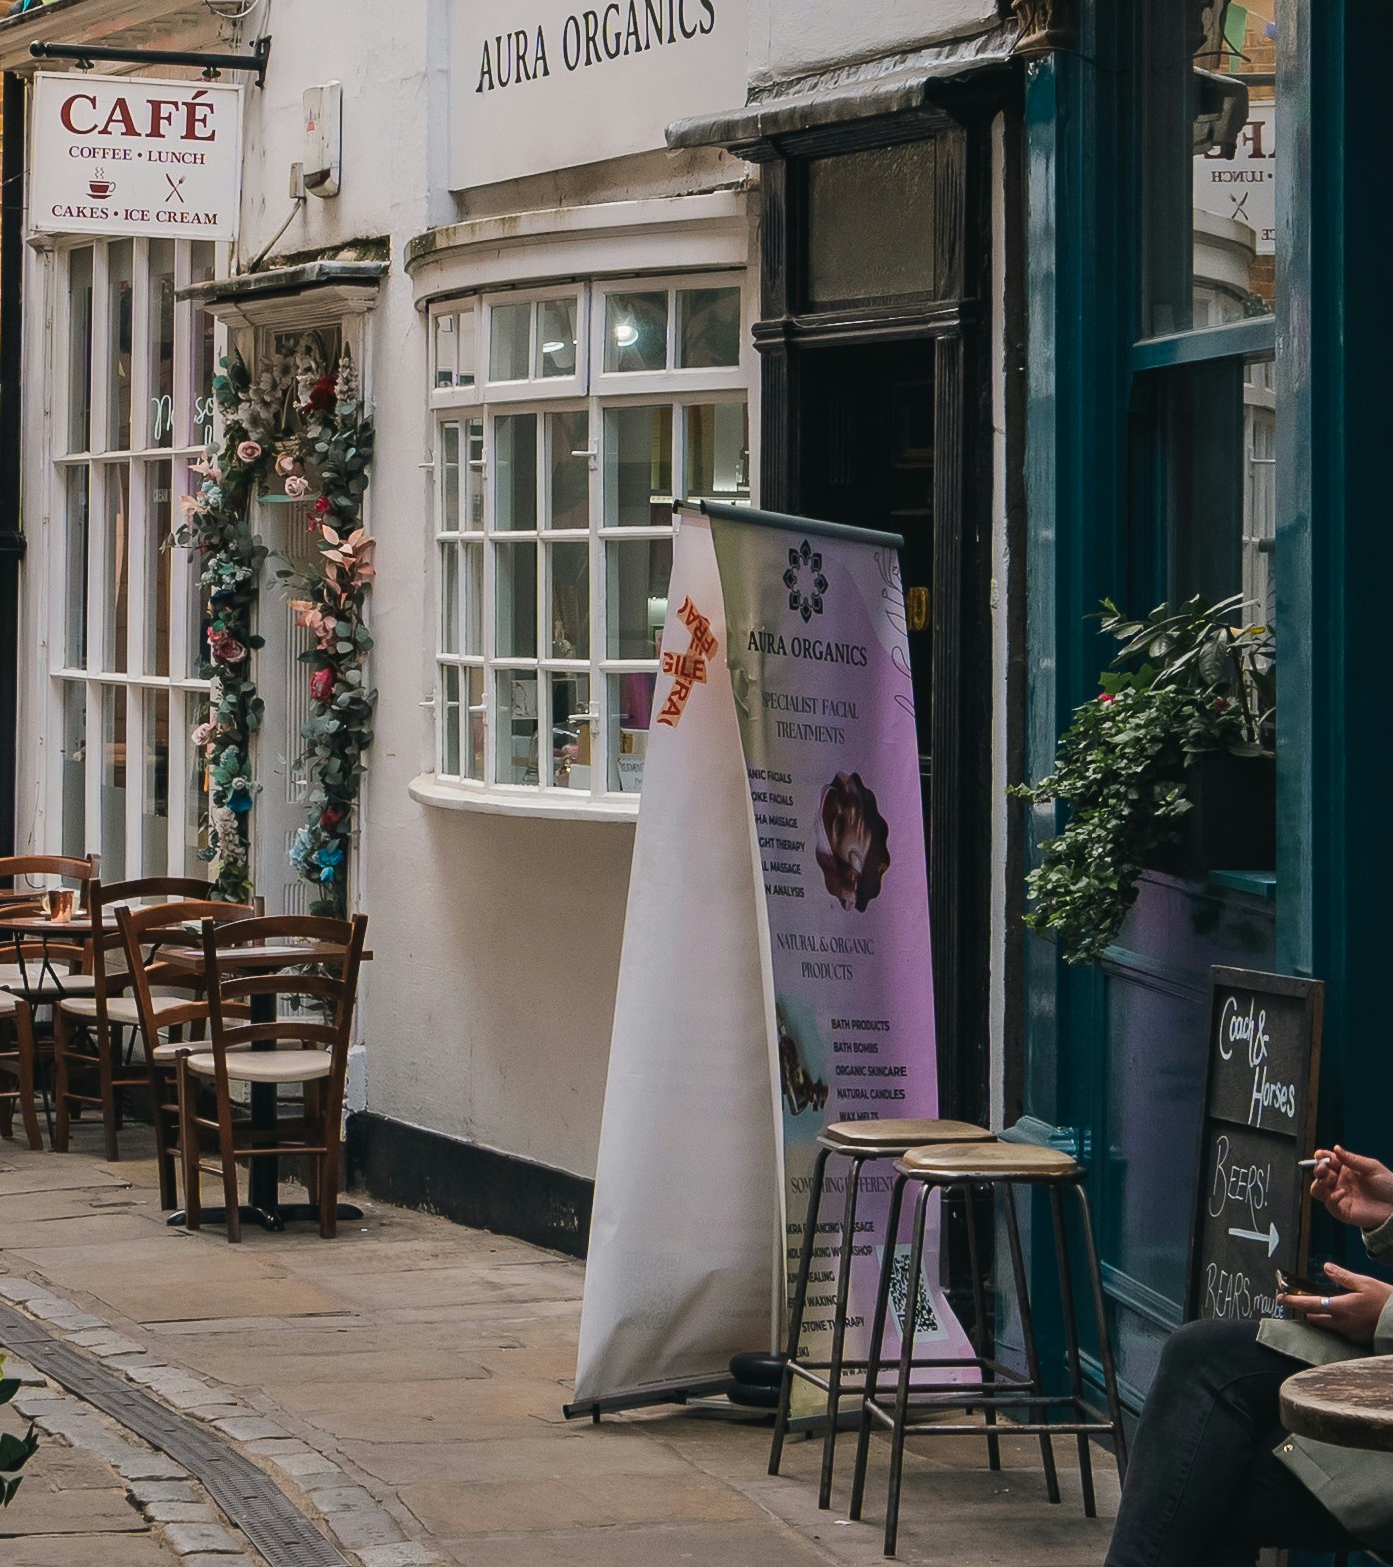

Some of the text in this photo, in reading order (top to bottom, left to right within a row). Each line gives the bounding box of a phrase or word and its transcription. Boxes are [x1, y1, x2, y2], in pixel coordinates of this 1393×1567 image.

[476, 24, 550, 94] AURA
[60, 90, 216, 142] CAFÉ
[68, 145, 206, 165] COFFEE LUNCH
[51, 204, 218, 225] CAKES ICE CREAM
[747, 630, 868, 667] AURA ORGANICS
[762, 689, 859, 720] SPECIALIST FACIAL
[775, 720, 845, 745] TREATMENTS
[767, 770, 792, 784] FACIALS
[769, 794, 794, 806] FACIALS
[768, 815, 798, 829] MASSAGE
[775, 838, 805, 852] THERAPY
[770, 862, 802, 875] MASSAGE
[773, 885, 805, 898] ANALYSIS
[776, 933, 819, 953] NATURAL
[829, 937, 875, 956] ORGANIC
[801, 961, 853, 981] PRODUCTS
[831, 1018, 890, 1032] BATH PRODUCTS
[1219, 996, 1255, 1068] Coach
[833, 1041, 879, 1054] BATH BOMBS
[835, 1066, 907, 1077] ORGANIC SKINCARE
[837, 1088, 906, 1100] NATURAL CANDLES
[1247, 1065, 1296, 1129] Horses
[1209, 1135, 1271, 1231] BEERS!
[802, 1320, 827, 1333] STONE
